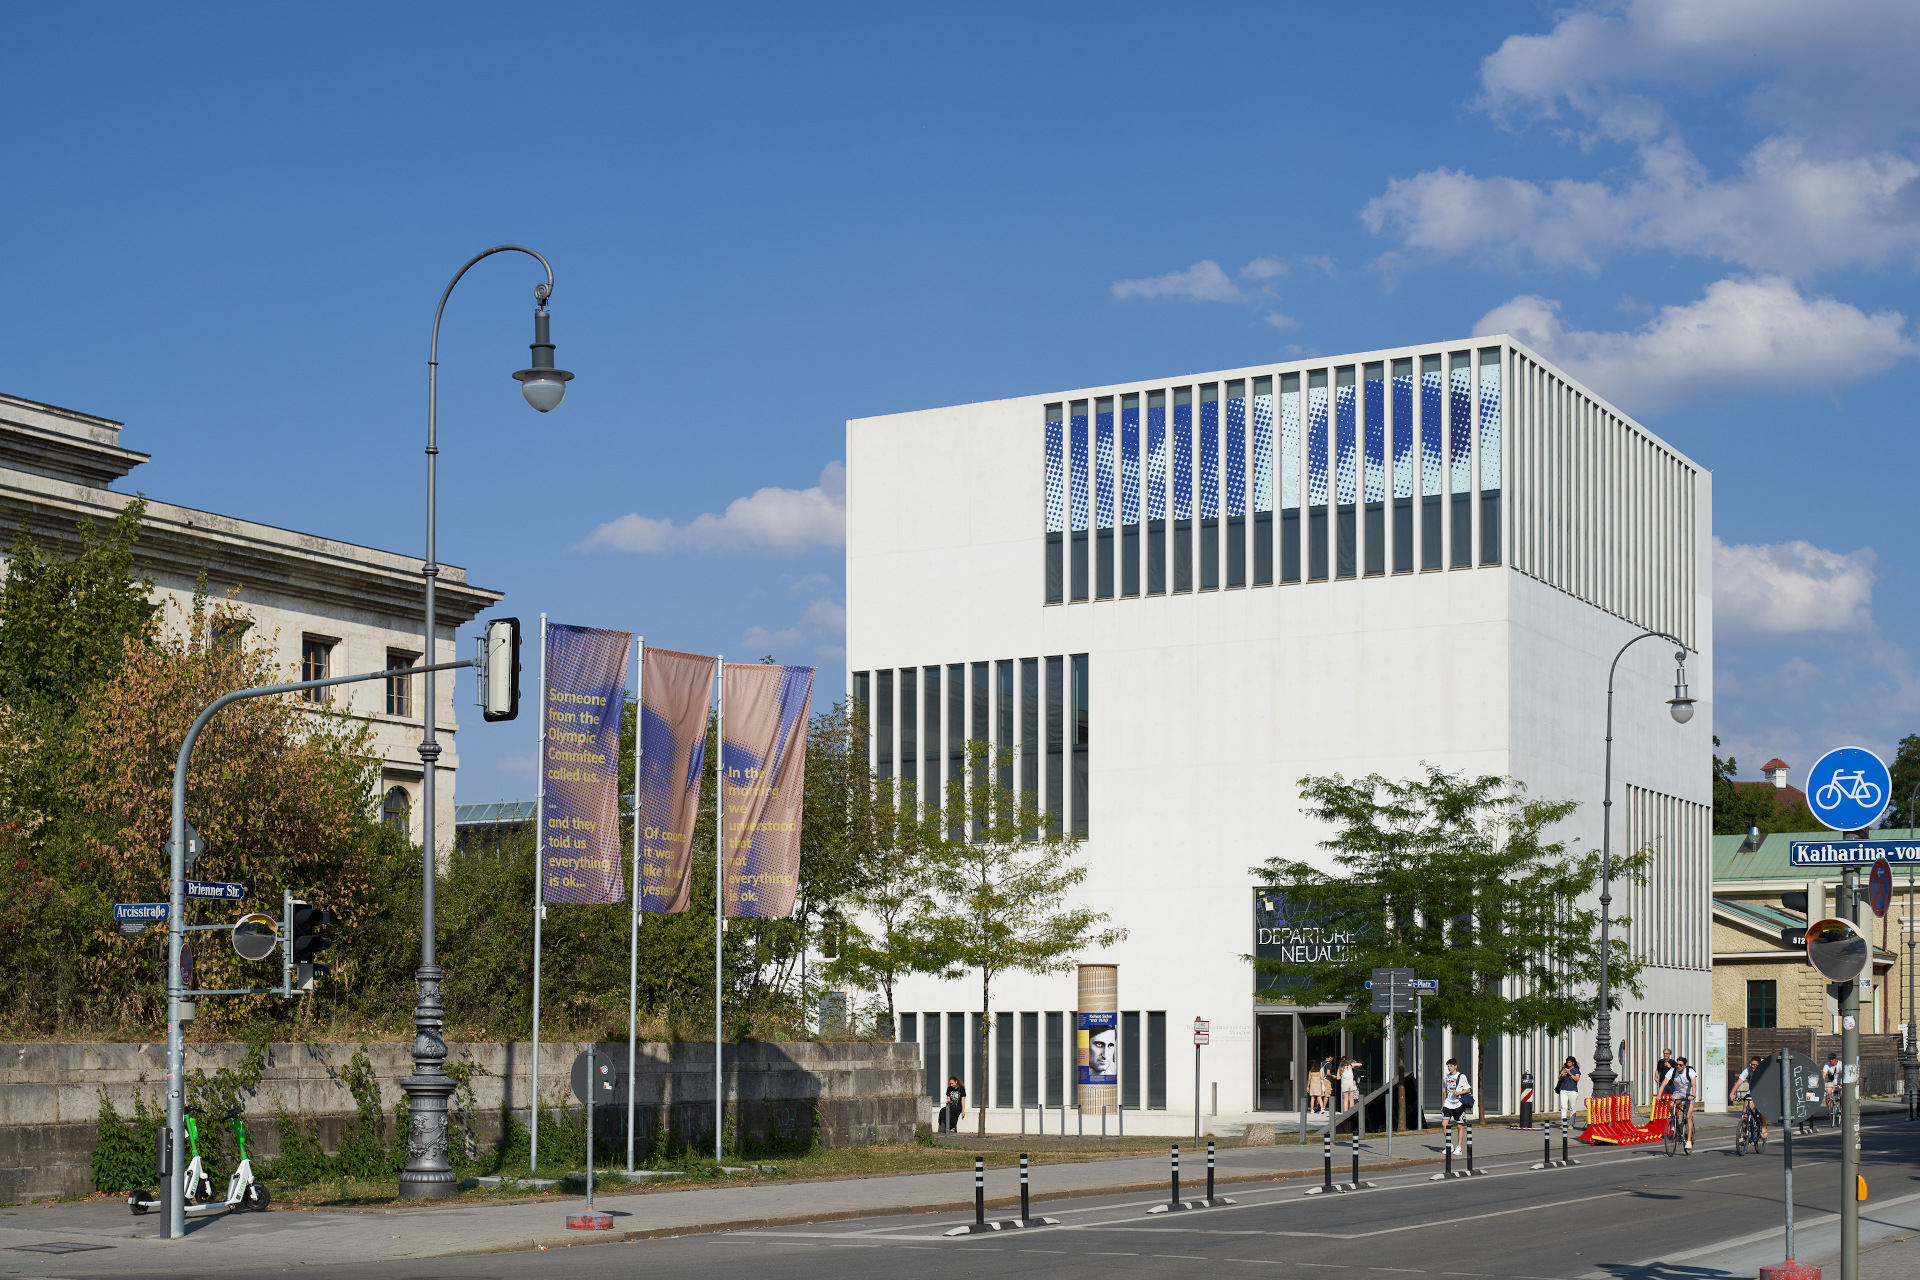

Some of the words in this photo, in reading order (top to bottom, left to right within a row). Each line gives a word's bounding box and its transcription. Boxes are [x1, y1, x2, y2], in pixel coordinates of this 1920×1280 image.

[549, 688, 607, 706] Someone
[549, 707, 576, 723] from
[579, 711, 600, 725] the
[549, 727, 596, 746] Olympic
[548, 768, 580, 780] called
[583, 772, 600, 782] us.
[728, 766, 741, 778] In
[744, 766, 765, 779] the
[728, 785, 779, 799] morning
[728, 804, 748, 814] we
[548, 816, 569, 829] and
[572, 816, 597, 833] they
[644, 827, 659, 840] Of
[548, 835, 570, 848] told
[574, 840, 587, 848] us
[728, 836, 752, 849] that
[644, 845, 653, 858] it
[655, 849, 675, 859] was
[549, 856, 611, 872] everything
[729, 855, 747, 867] not
[643, 863, 662, 877] like
[664, 865, 671, 878] it
[549, 873, 559, 887] is
[562, 874, 586, 887] ok...
[728, 871, 794, 887] everything
[188, 882, 224, 896] Brienner
[226, 884, 240, 898] Str.
[728, 889, 738, 901] is
[116, 905, 166, 919] Arcisstraße
